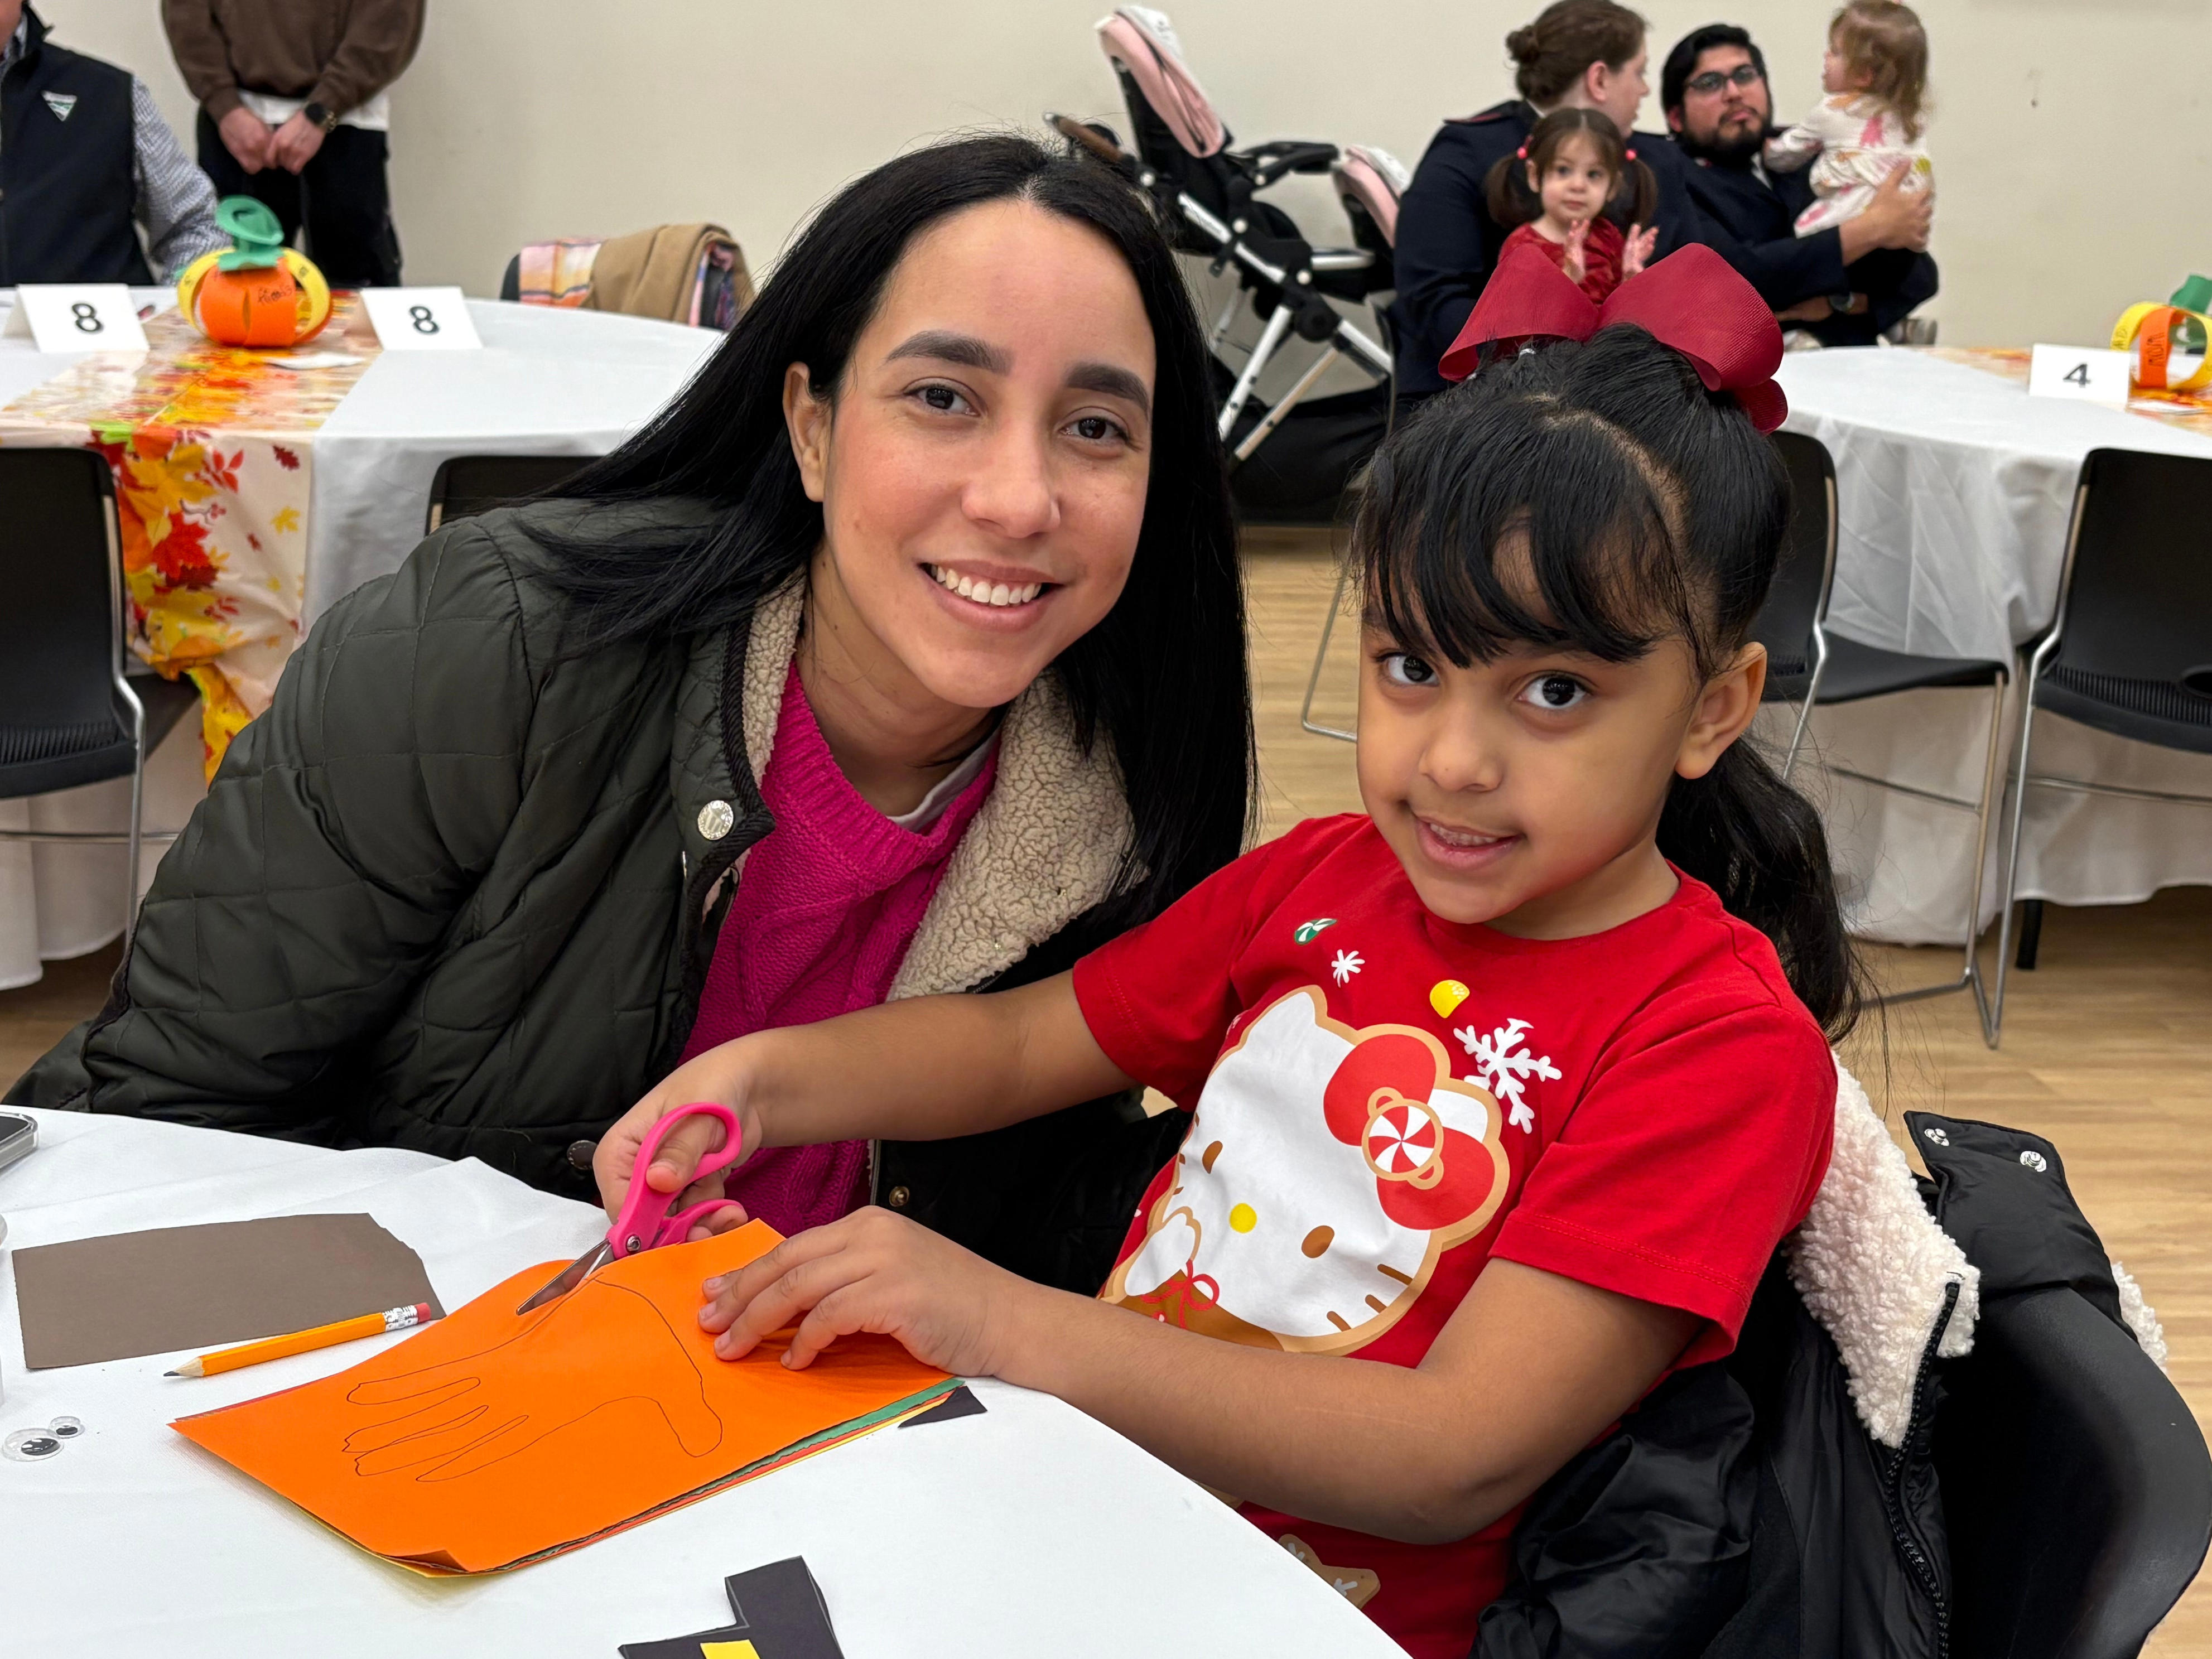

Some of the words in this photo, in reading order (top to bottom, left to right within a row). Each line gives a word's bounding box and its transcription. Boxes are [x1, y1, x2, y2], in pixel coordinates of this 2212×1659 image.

[71, 303, 103, 332] 8
[409, 306, 440, 333] 8
[2063, 364, 2091, 388] 4
